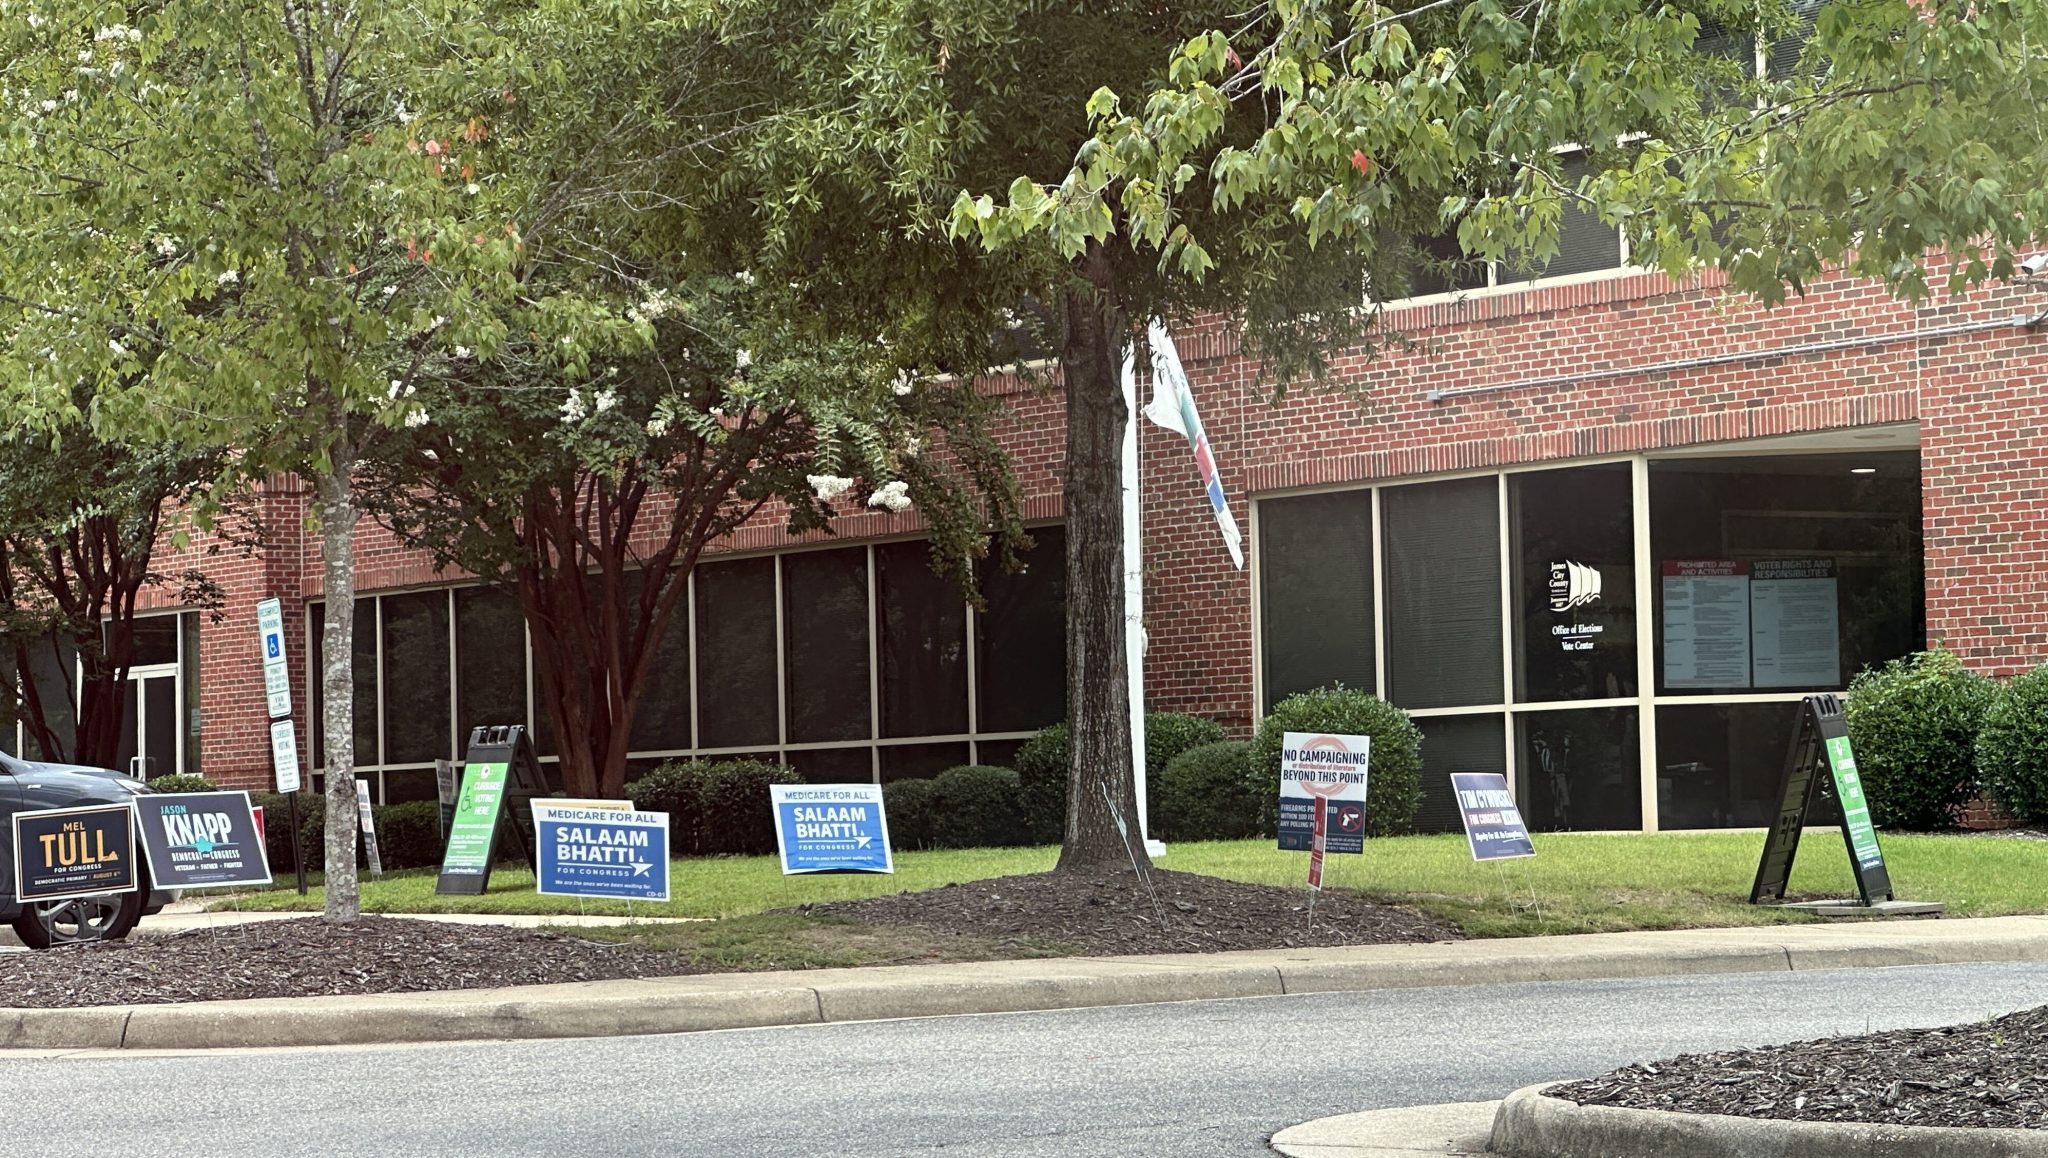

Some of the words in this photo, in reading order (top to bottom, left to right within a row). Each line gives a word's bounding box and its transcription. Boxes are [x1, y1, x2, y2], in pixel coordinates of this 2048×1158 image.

[1551, 562, 1566, 572] James
[1677, 561, 1717, 569] PROHIBITED
[1718, 560, 1736, 568] AREA
[1754, 561, 1781, 570] VOTER
[1782, 560, 1812, 569] RIGHTS
[1813, 559, 1832, 568] AND
[1553, 571, 1564, 580] City
[1754, 568, 1828, 579] RESPONSIBILITIES
[1549, 579, 1569, 588] County
[1552, 625, 1570, 635] Office
[1571, 624, 1577, 634] of
[1578, 624, 1603, 633] Elections
[1562, 641, 1574, 650] Vote
[1575, 641, 1594, 650] Center
[1284, 749, 1297, 762] NO
[1299, 750, 1366, 765] CAMPAIGNING
[1283, 770, 1316, 782] BEYOND
[1318, 771, 1337, 783] THIS
[1339, 773, 1365, 784] POINT
[475, 794, 496, 803] VOTING
[785, 792, 831, 800] MEDICARE
[834, 791, 851, 799] FOR
[854, 791, 870, 799] ALL
[160, 805, 187, 815] JASON
[474, 806, 490, 815] HERE
[1281, 804, 1307, 812] FIREARMS
[547, 809, 606, 821] MEDICARE
[610, 812, 632, 822] FOR
[635, 814, 657, 823] ALL
[793, 807, 866, 822] SALAAM
[63, 821, 85, 832] MEL
[161, 812, 232, 847] KNAPP
[796, 823, 858, 838] BHATTI
[556, 826, 648, 847] SALAAM
[39, 829, 118, 867] TULL
[557, 844, 635, 863] BHATTI
[171, 851, 203, 861] DEMOCRAT
[211, 849, 240, 859] CONGRESS
[69, 863, 102, 872] CONGRESS
[224, 861, 243, 869] FIGHTER
[579, 868, 630, 877] CONGRESS
